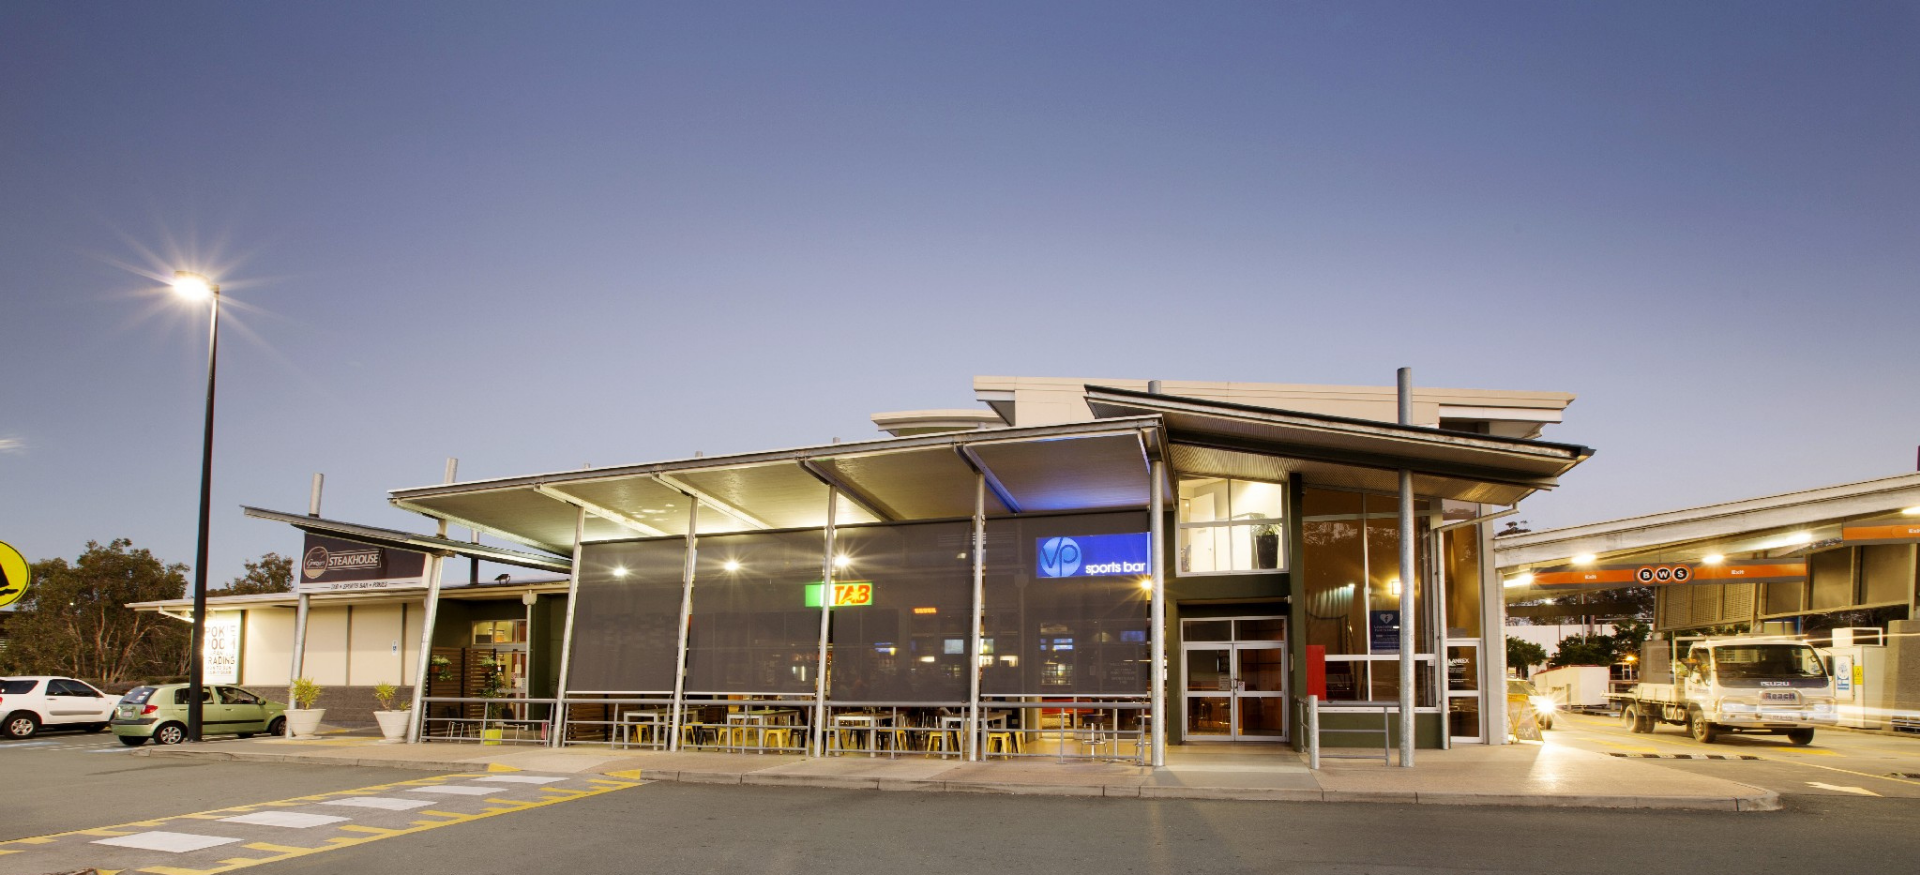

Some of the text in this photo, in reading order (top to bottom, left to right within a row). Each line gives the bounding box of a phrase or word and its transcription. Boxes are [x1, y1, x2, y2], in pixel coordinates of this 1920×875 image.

[328, 553, 379, 567] STEAKHOUSE
[1085, 561, 1146, 575] sports bar
[834, 585, 870, 605] TAB
